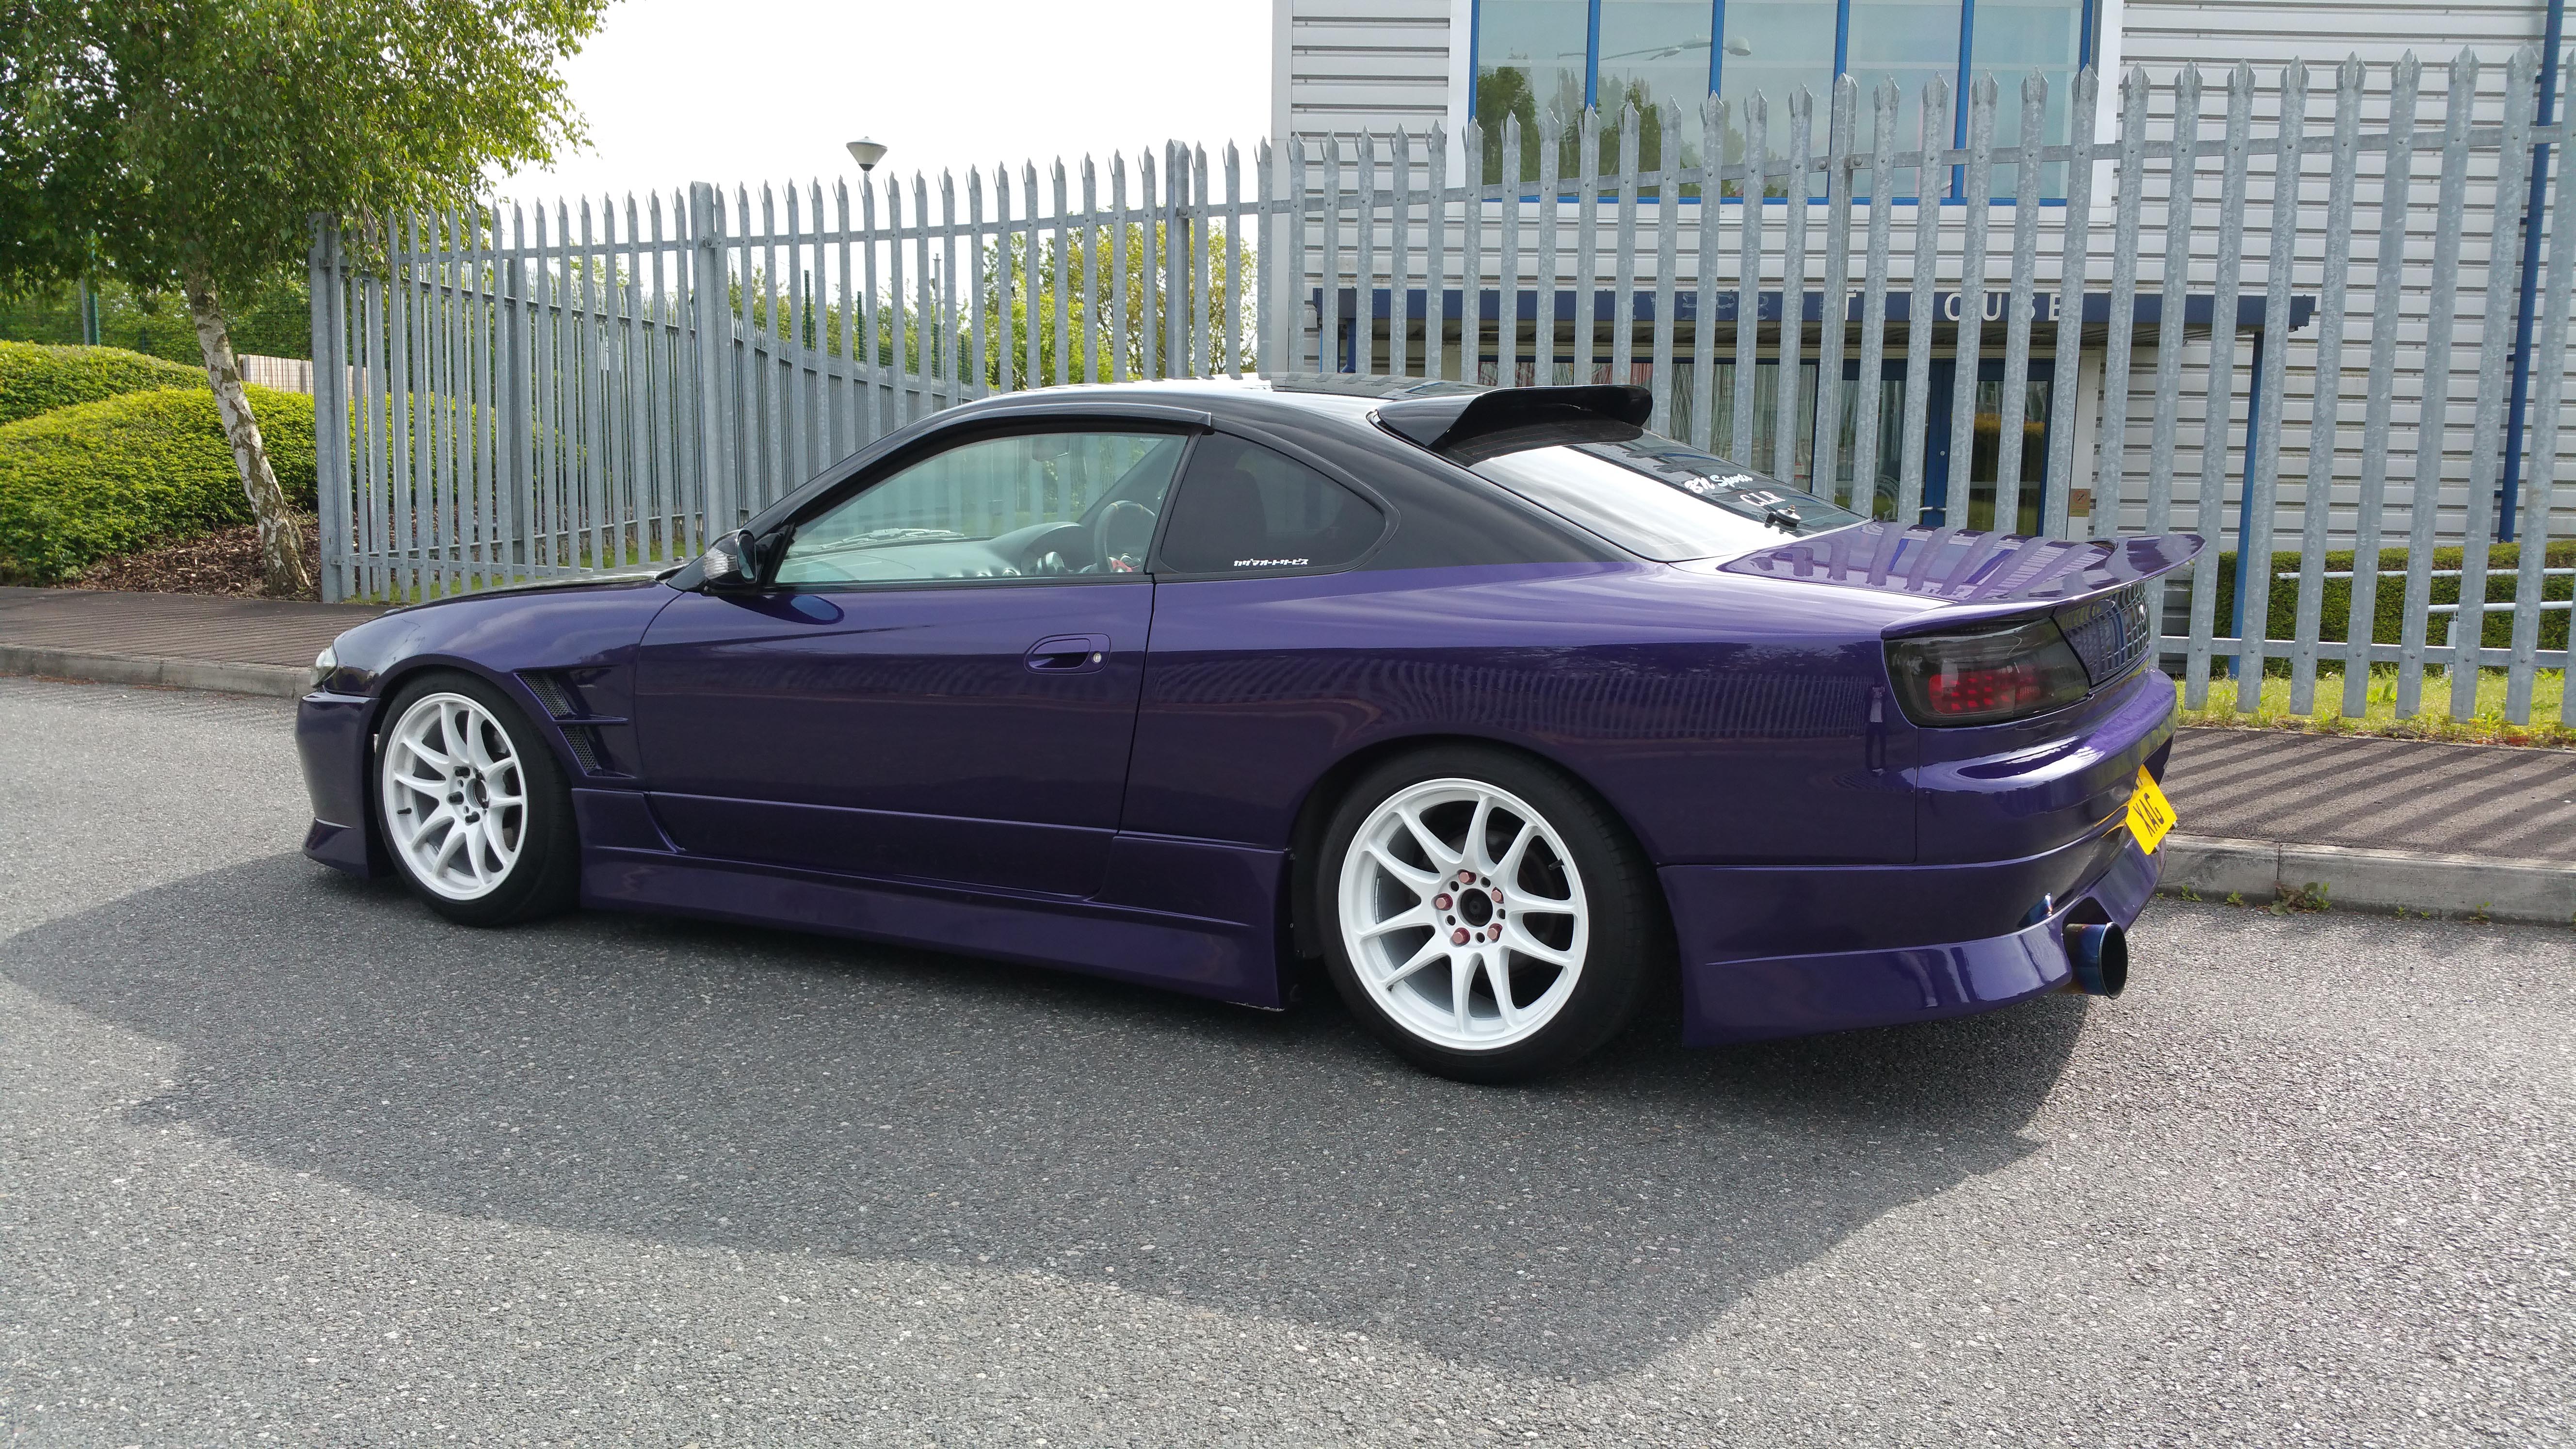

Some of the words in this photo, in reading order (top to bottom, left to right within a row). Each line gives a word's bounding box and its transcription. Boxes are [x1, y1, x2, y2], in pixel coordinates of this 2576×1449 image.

[1684, 477, 1715, 494] BN
[1234, 558, 1309, 566] カザマオートサービス
[2133, 792, 2164, 837] XAG
